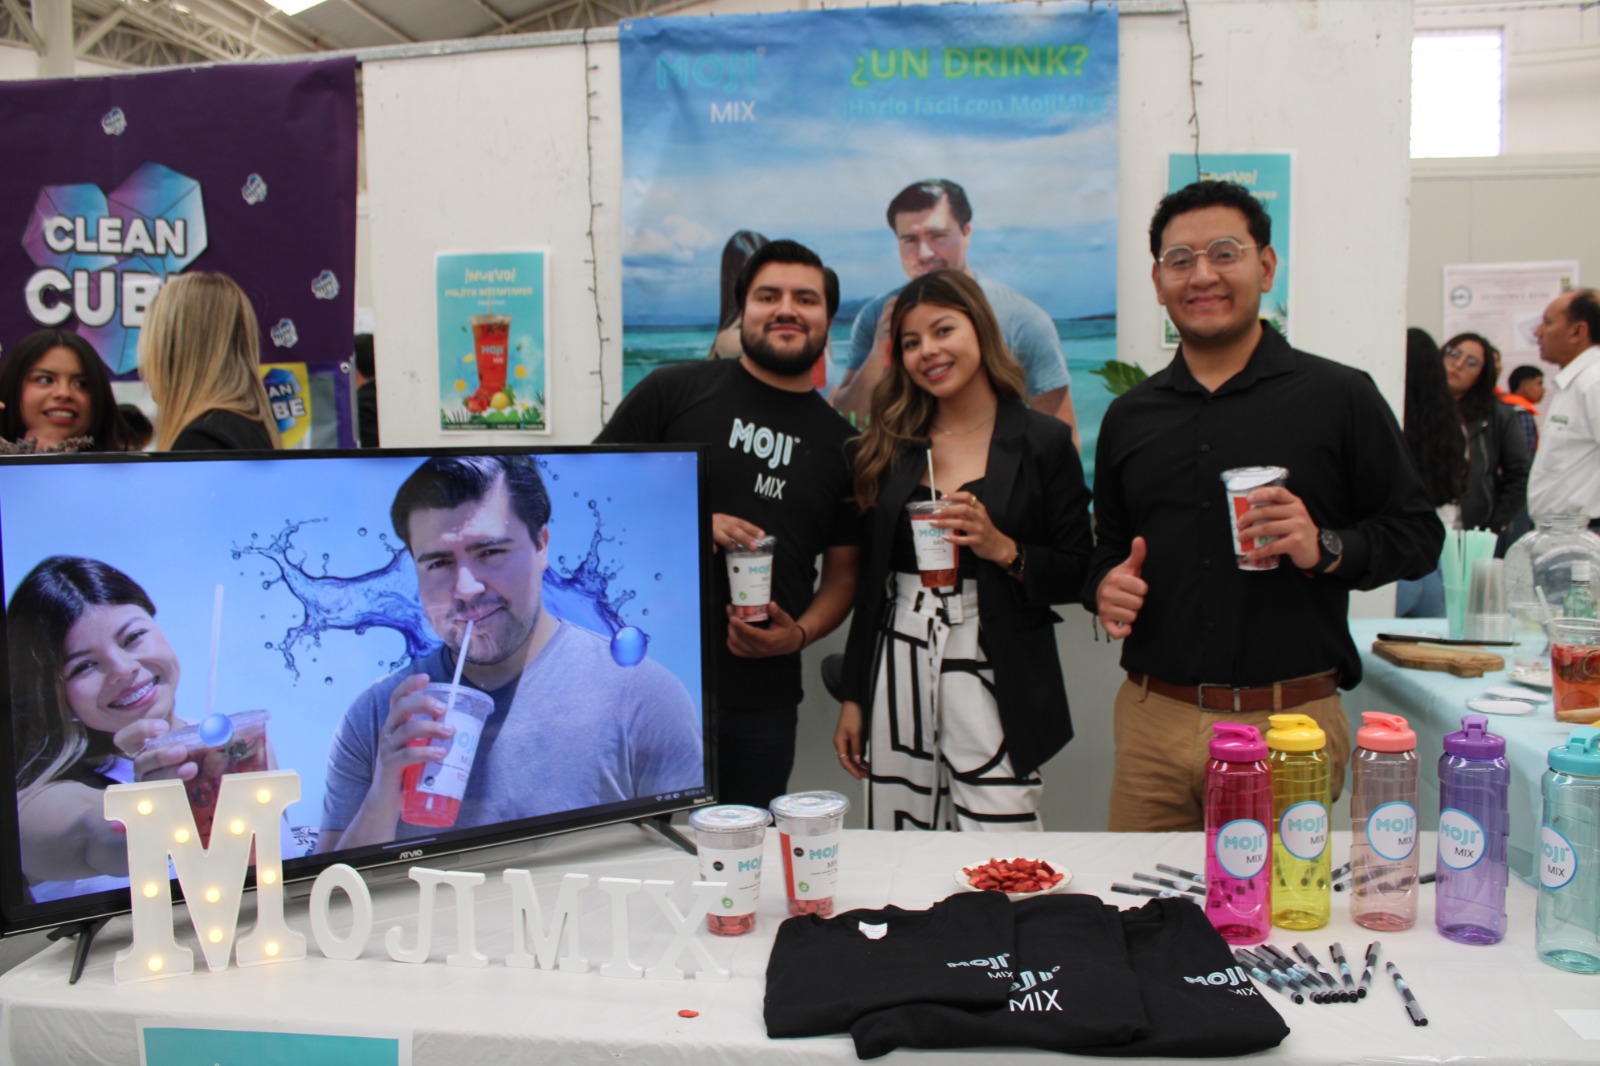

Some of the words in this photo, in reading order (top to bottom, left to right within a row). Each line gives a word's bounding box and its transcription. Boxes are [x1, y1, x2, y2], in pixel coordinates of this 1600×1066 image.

[850, 49, 930, 88] ¿UN
[943, 44, 1089, 80] DRINK?
[710, 99, 757, 124] MIX
[44, 215, 185, 256] CLEAN
[25, 268, 182, 327] CUB
[729, 418, 793, 469] MOJI
[754, 473, 786, 500] MIX
[1288, 816, 1325, 833] MOJI
[1376, 818, 1414, 835] MOJI
[1441, 821, 1477, 846] MOJI
[1224, 835, 1264, 852] MOJI
[1310, 835, 1324, 845] MIX
[1398, 836, 1413, 846] MIX
[399, 849, 424, 859] ATVIO
[1246, 854, 1263, 864] MIX
[1455, 847, 1474, 859] MIX
[1541, 842, 1566, 863] OJI
[1547, 864, 1565, 878] MIX
[987, 971, 1014, 980] MIX
[1183, 966, 1248, 986] MOJI
[1009, 989, 1063, 1012] MIX
